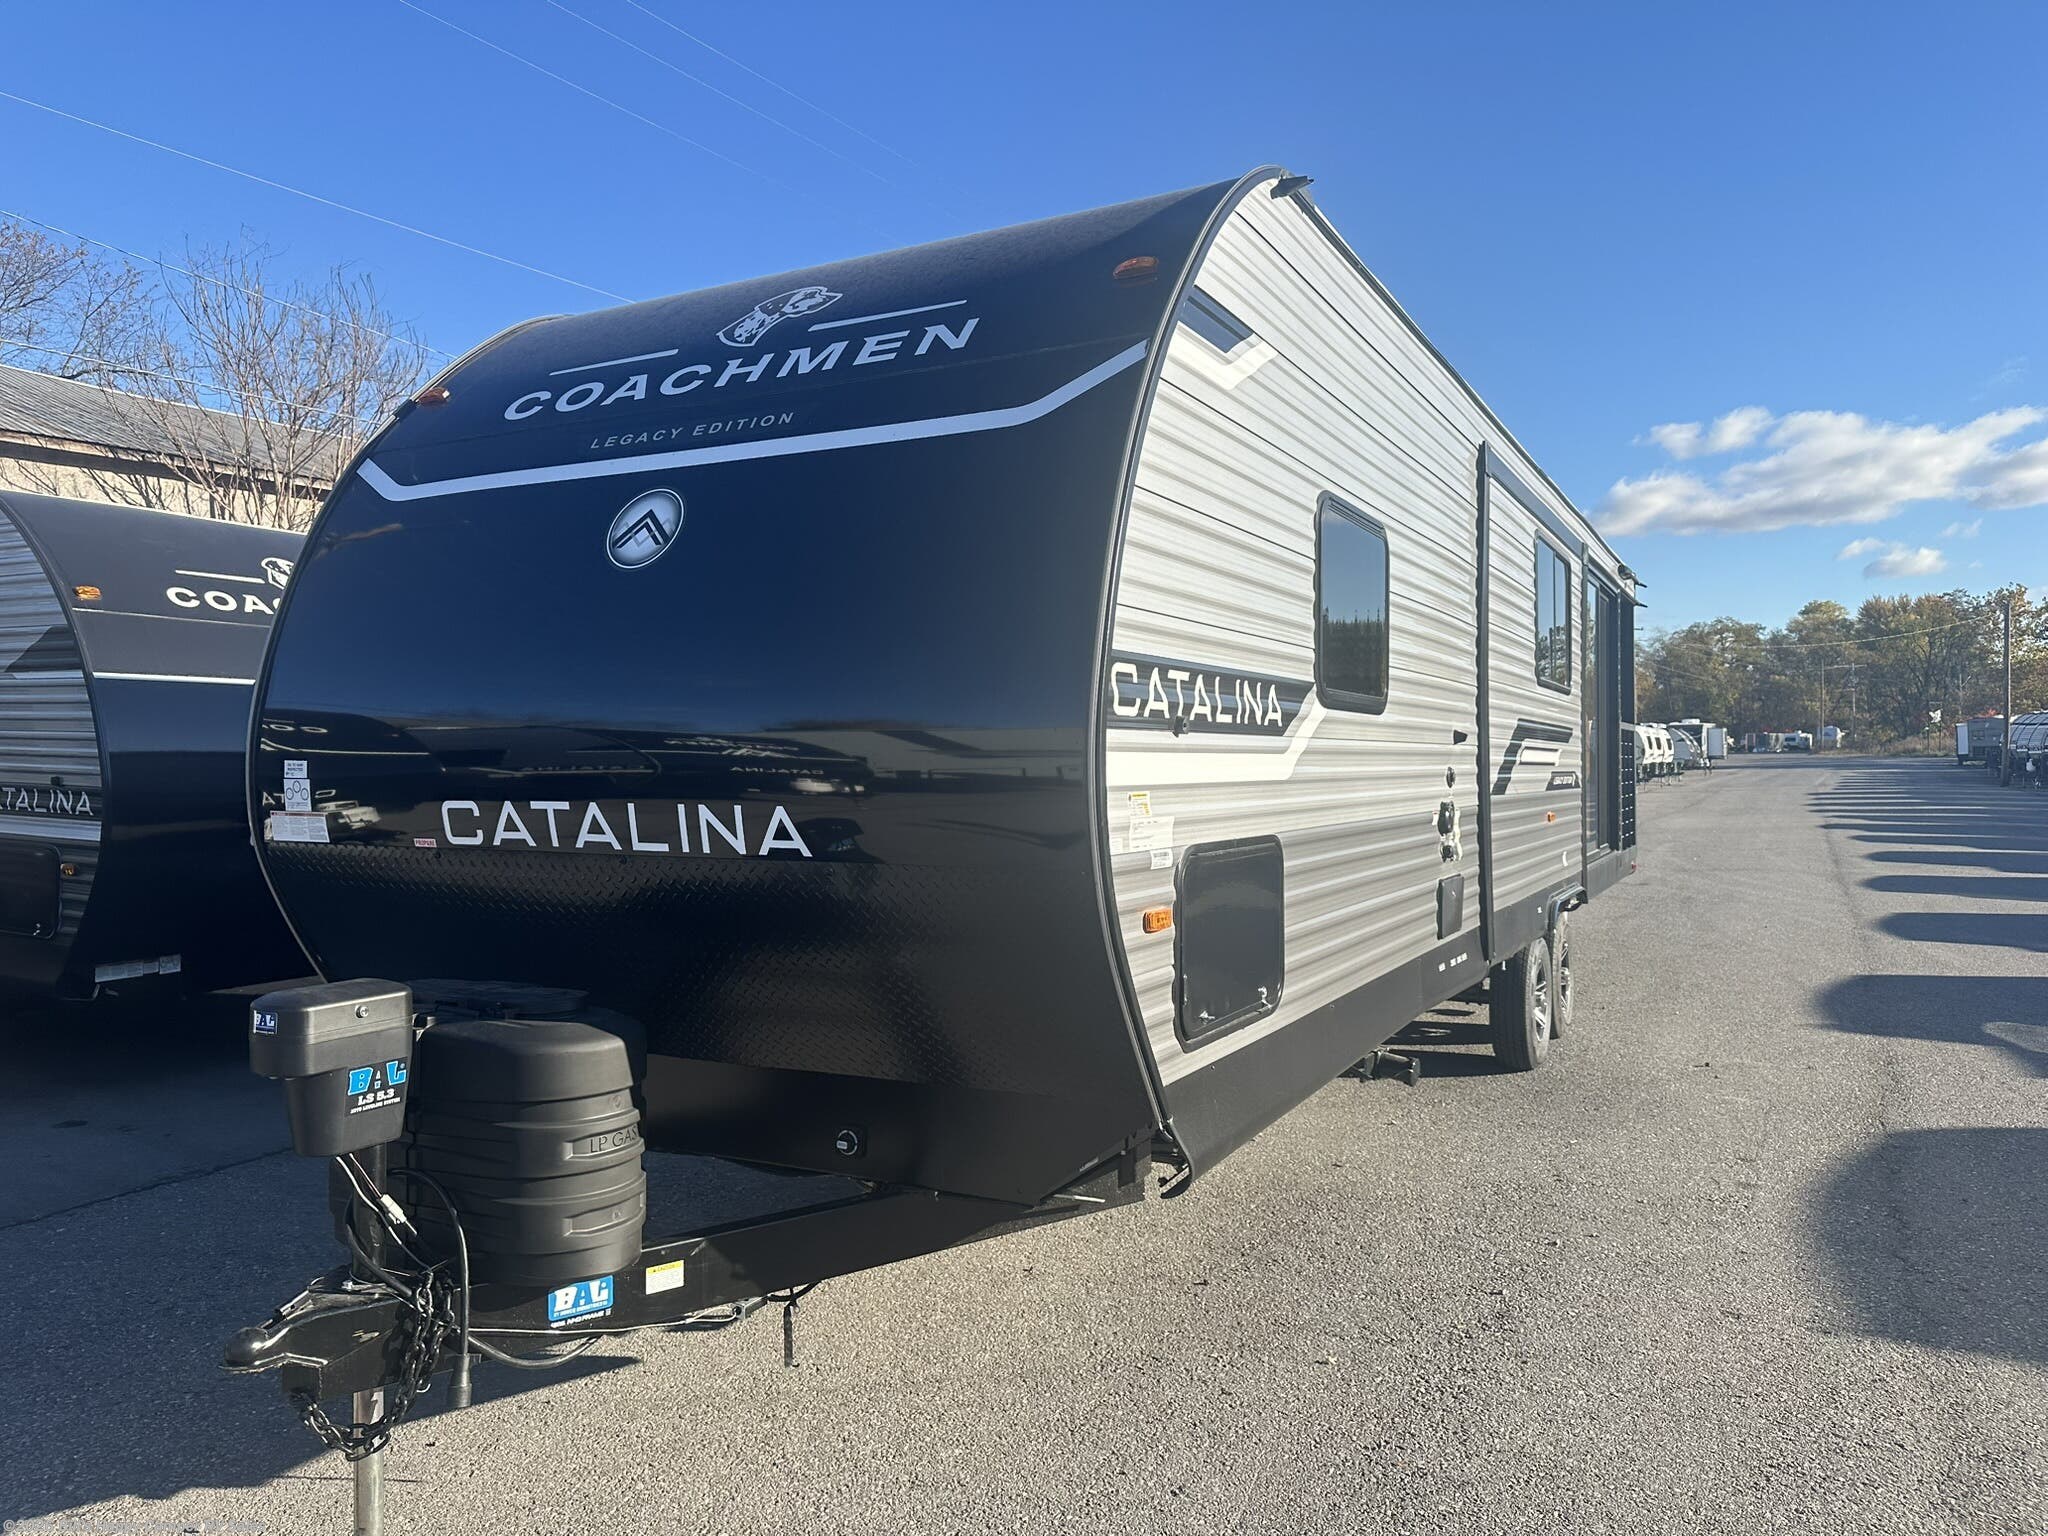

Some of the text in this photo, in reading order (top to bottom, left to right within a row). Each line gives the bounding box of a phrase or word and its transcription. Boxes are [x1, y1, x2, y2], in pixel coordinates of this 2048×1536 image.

[503, 317, 980, 422] COACHMEN
[590, 412, 795, 449] LEGACY EDITION
[1110, 662, 1283, 727] CATALINA
[0, 787, 94, 816] TALINA
[441, 800, 813, 858] CATALINA
[347, 1060, 407, 1096] BAL
[554, 1279, 609, 1312] BAL
